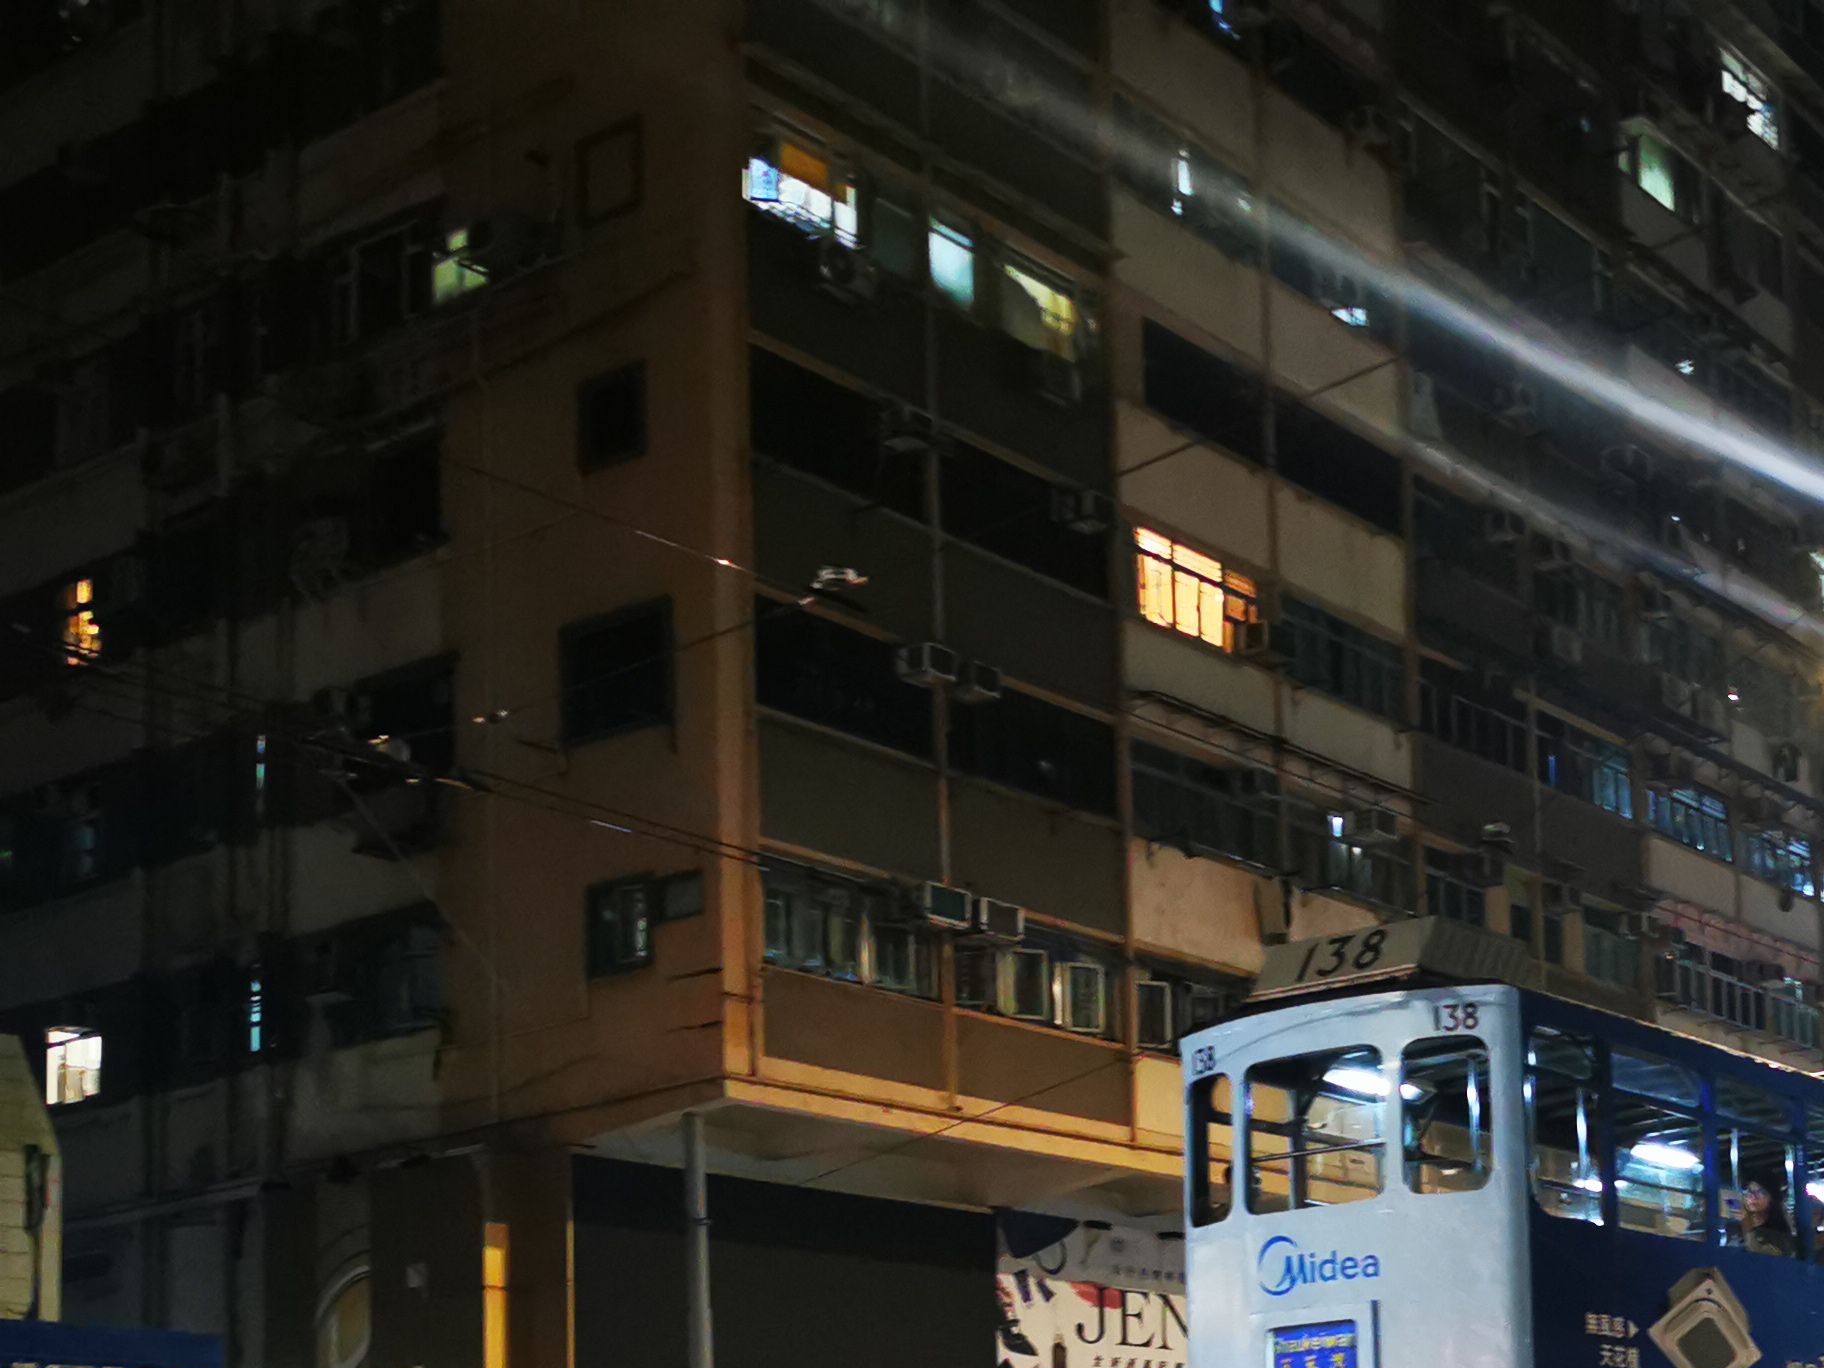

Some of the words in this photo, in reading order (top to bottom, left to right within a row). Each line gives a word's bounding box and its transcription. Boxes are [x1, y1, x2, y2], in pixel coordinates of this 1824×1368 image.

[1297, 928, 1387, 981] 138
[1432, 1001, 1480, 1033] 138
[1257, 1234, 1381, 1297] Midea
